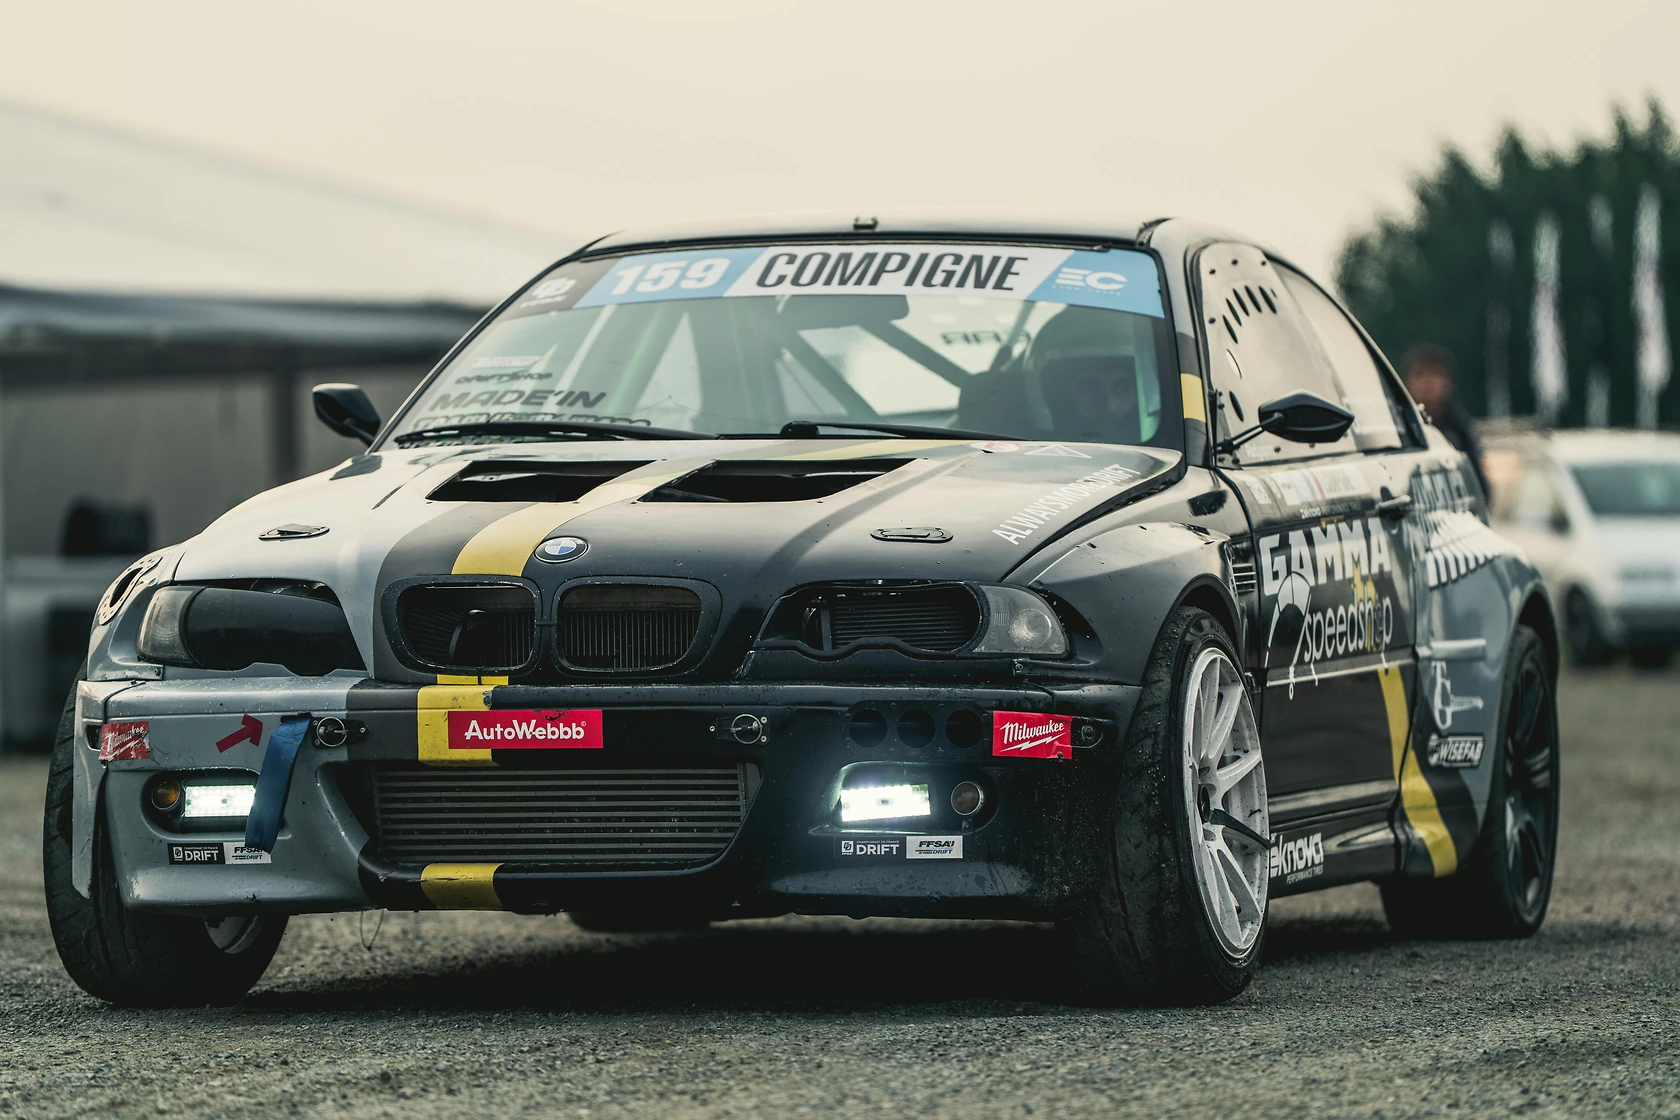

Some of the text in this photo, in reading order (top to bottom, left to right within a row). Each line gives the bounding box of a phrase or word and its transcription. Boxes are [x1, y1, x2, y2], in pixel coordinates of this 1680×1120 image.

[611, 257, 731, 297] 159
[756, 251, 1029, 291] COMPIGNE
[1055, 267, 1128, 290] EC
[1258, 516, 1392, 597] GAMMA
[464, 719, 585, 740] AutoWebbb
[1000, 719, 1065, 745] Milwaukee
[1440, 741, 1484, 765] WISEFAB
[184, 850, 219, 861] DRIFT
[856, 844, 899, 855] DRIFT
